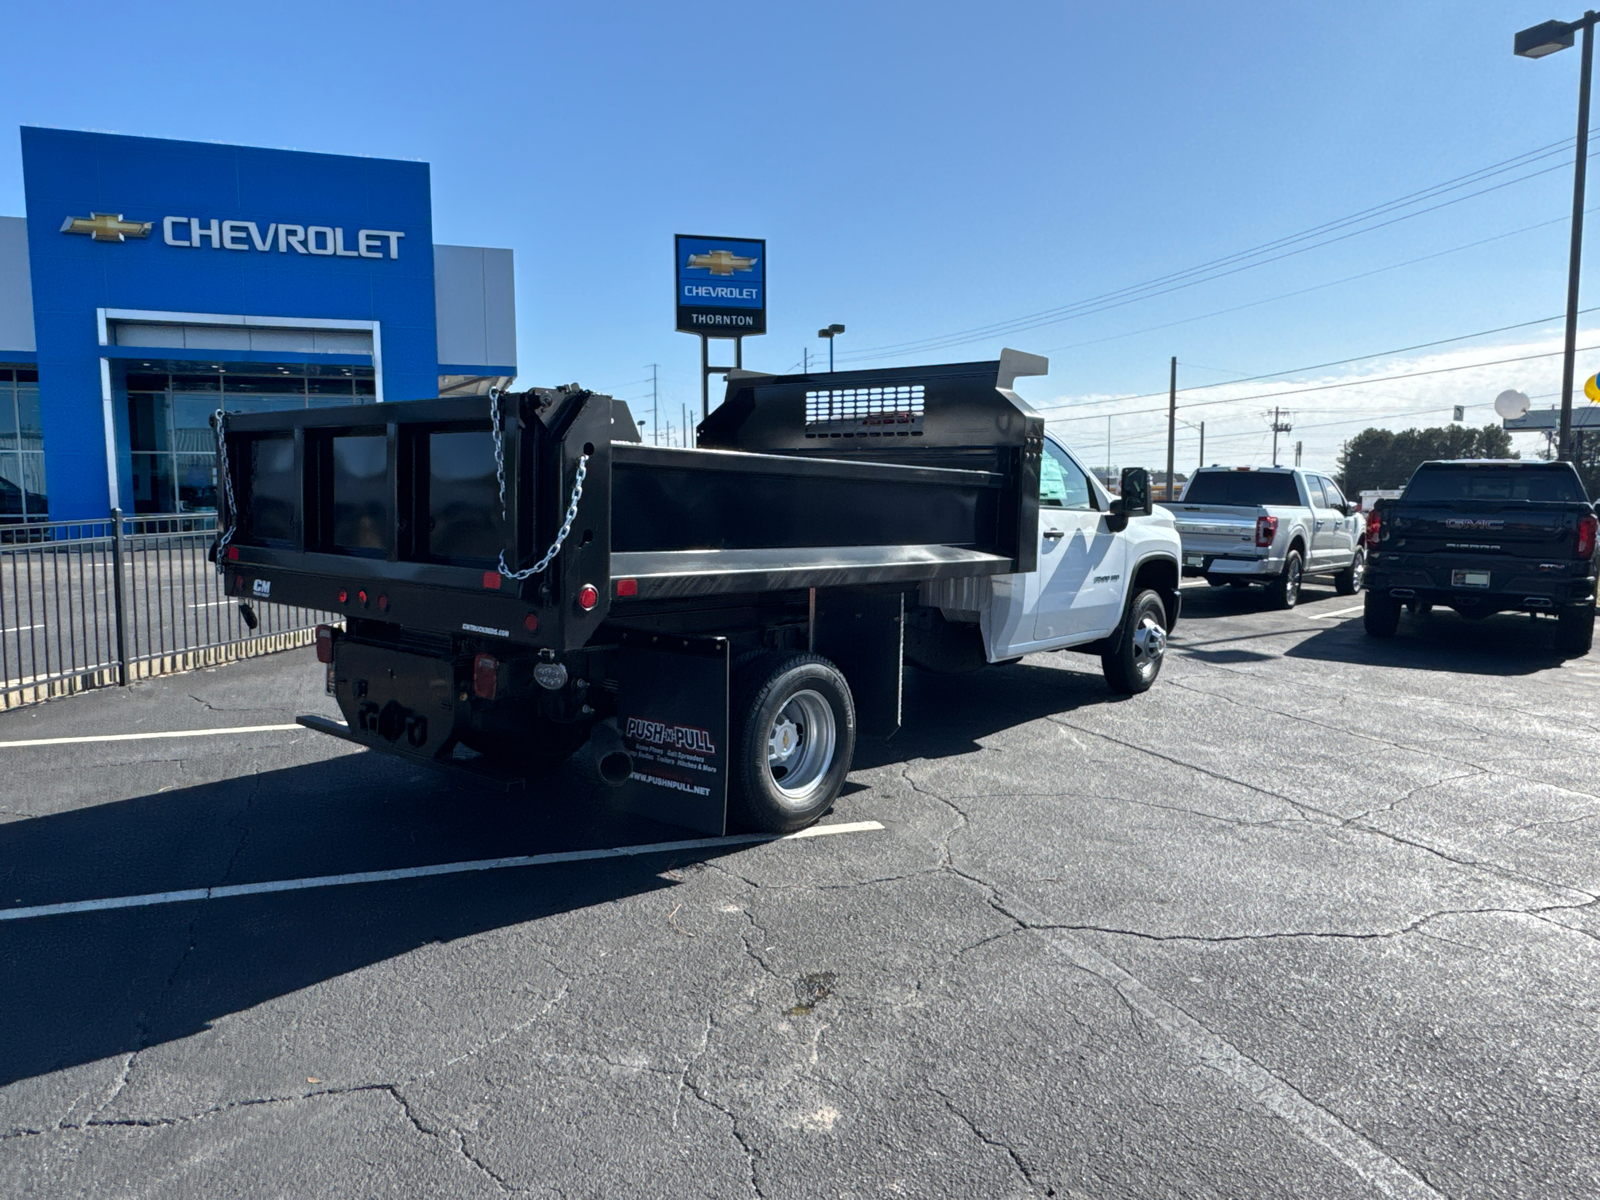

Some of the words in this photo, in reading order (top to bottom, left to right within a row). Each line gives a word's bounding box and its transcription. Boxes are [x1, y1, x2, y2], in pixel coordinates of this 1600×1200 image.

[163, 215, 406, 260] CHEVROLET
[684, 285, 758, 299] CHEVROLET
[691, 313, 753, 326] THORNTON
[1446, 518, 1506, 530] GMC
[253, 579, 271, 593] CM
[678, 751, 705, 763] Spreaders
[676, 760, 697, 770] Hitches
[702, 764, 717, 774] More
